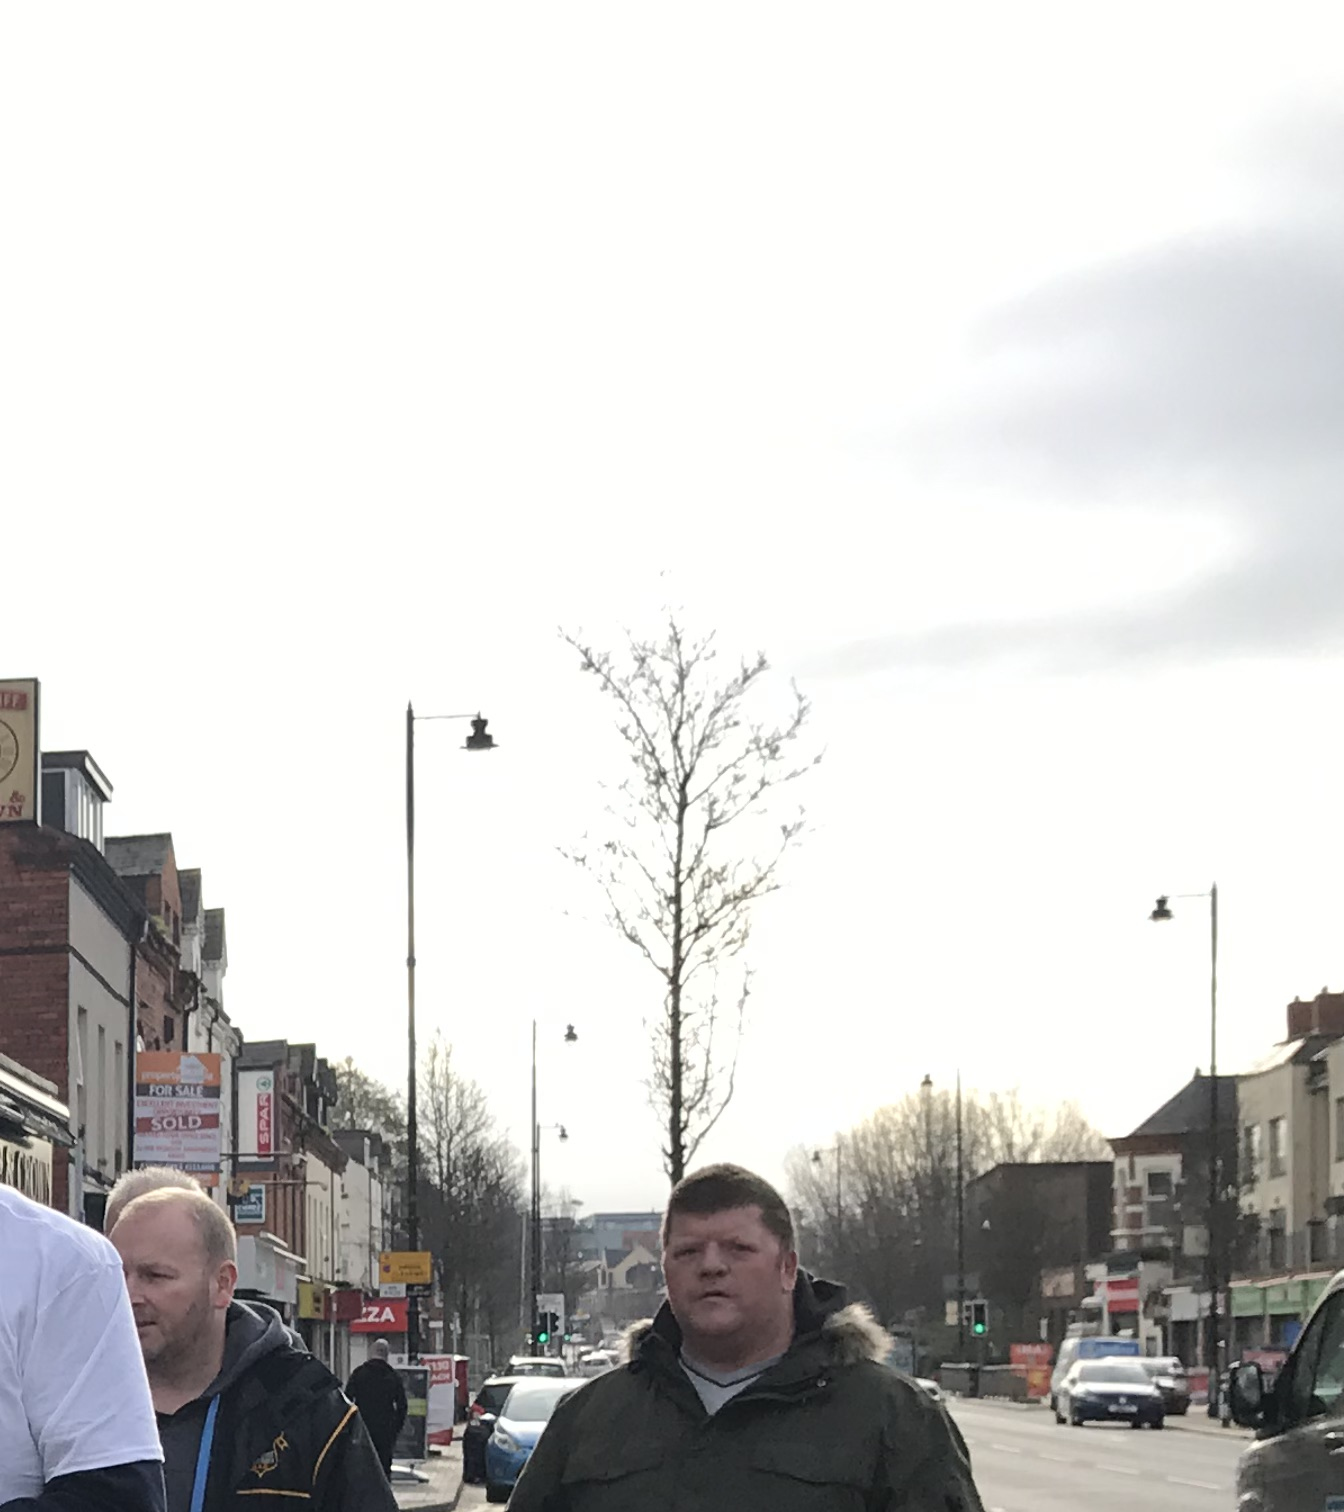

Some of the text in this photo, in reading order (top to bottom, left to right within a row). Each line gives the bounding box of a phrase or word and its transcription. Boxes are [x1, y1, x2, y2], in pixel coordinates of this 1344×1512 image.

[149, 1084, 204, 1098] FOR SALE
[151, 1115, 202, 1131] SOLD
[258, 1093, 270, 1145] SPAR
